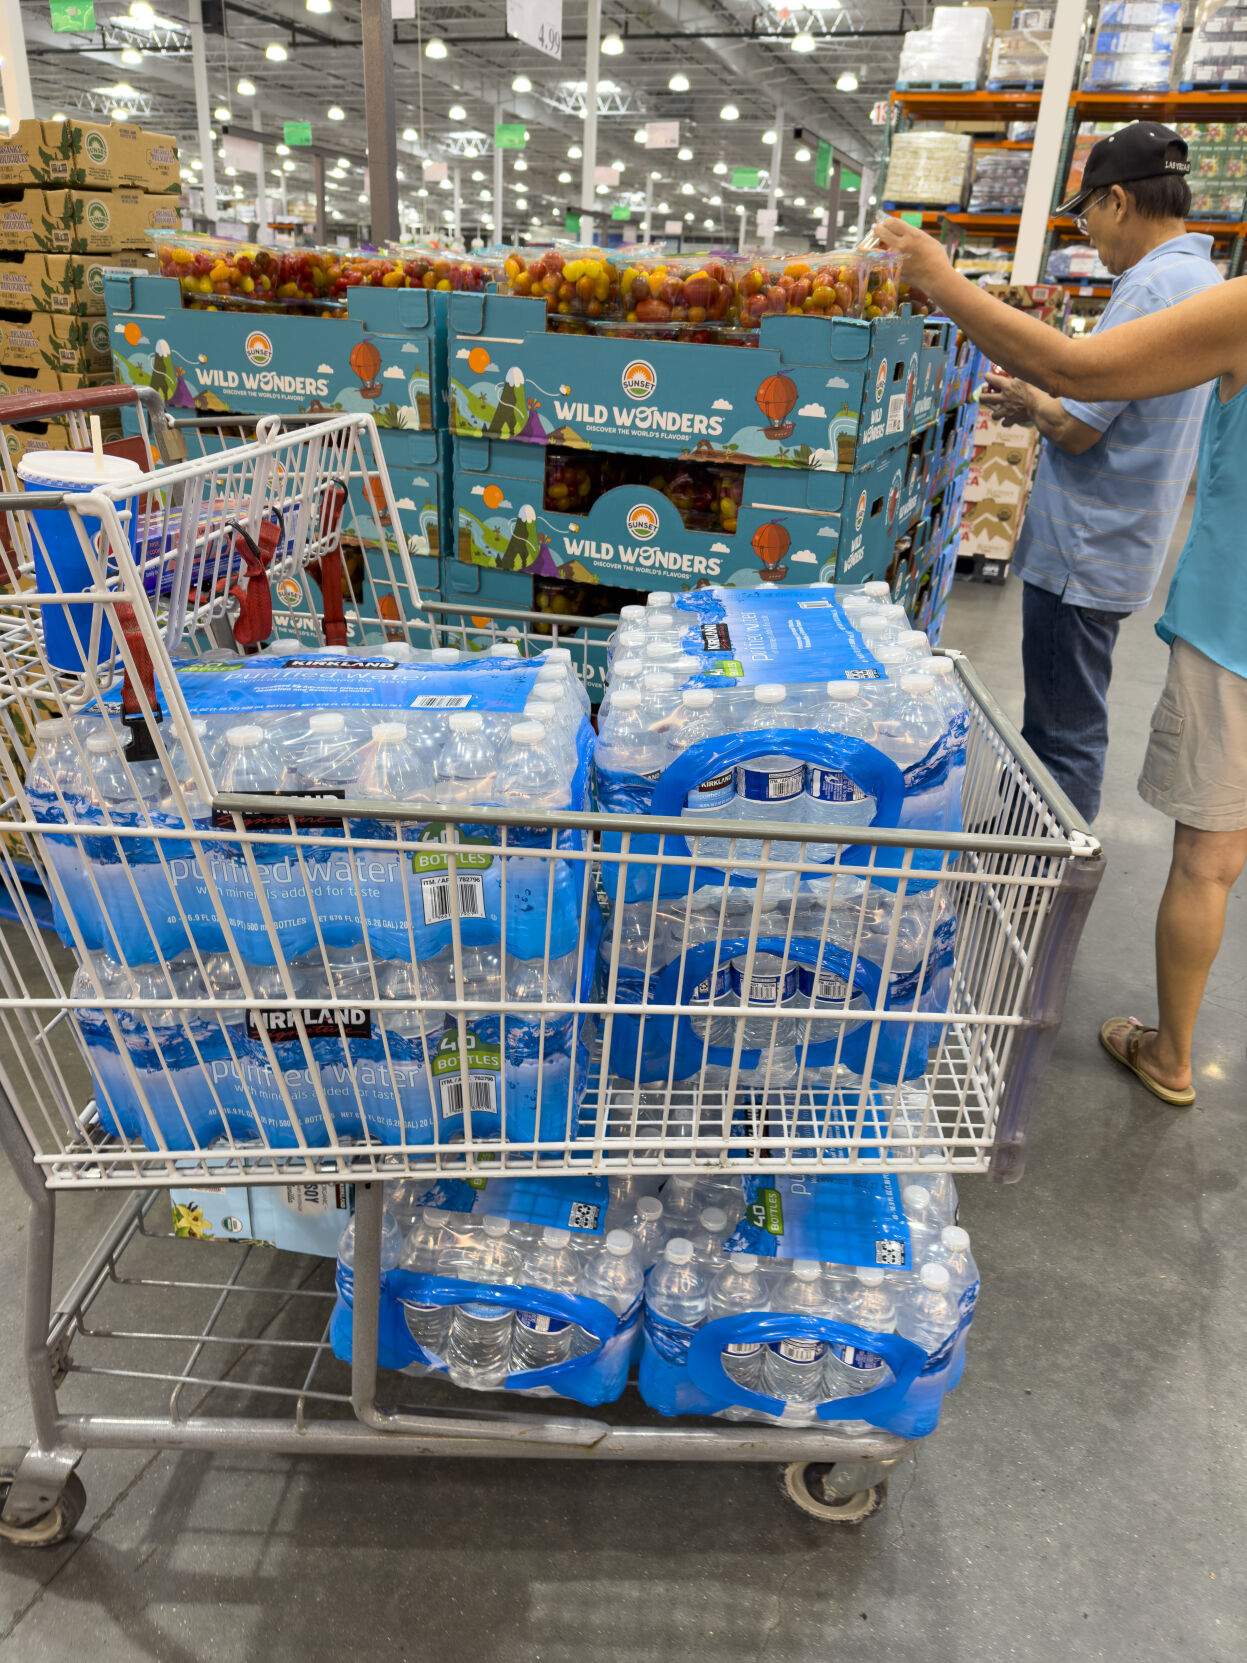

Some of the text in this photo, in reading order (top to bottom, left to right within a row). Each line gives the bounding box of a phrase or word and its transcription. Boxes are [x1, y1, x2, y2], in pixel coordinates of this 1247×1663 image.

[539, 24, 560, 54] 4.99
[247, 348, 272, 358] SUNSET
[195, 367, 329, 396] WILD WONDERS
[623, 380, 656, 391] SUNSET
[222, 388, 247, 396] DISCOVER
[554, 400, 724, 436] WILD WONDERS
[586, 425, 617, 434] DISCOVER
[618, 428, 630, 436] THE
[631, 429, 660, 438] WORLD'S
[628, 522, 658, 532] SUNSET
[563, 537, 721, 576] WILD WONDERS
[593, 560, 622, 570] DISCOVER
[623, 564, 635, 572] THE
[635, 566, 662, 576] WORLD'S
[292, 660, 395, 668] KIRKLAND
[224, 670, 429, 682] purified water
[701, 773, 731, 789] KIRKLAND
[419, 852, 486, 867] BOTLES
[170, 856, 398, 885] purified water
[196, 885, 223, 895] wh
[226, 887, 277, 900] minerls
[281, 886, 322, 898] addd
[326, 885, 344, 896] for
[247, 923, 259, 931] 500
[273, 917, 307, 930] BOTTLES
[440, 1035, 475, 1051] 40
[438, 1055, 499, 1070] BOTLES
[211, 1060, 420, 1087] purifed water
[260, 1091, 308, 1100] minals
[312, 1087, 349, 1097] ded
[373, 1090, 400, 1100] tast
[419, 1119, 428, 1128] 20
[304, 1184, 319, 1204] SOY
[752, 1204, 766, 1228] 40
[769, 1193, 780, 1231] BOTTLES
